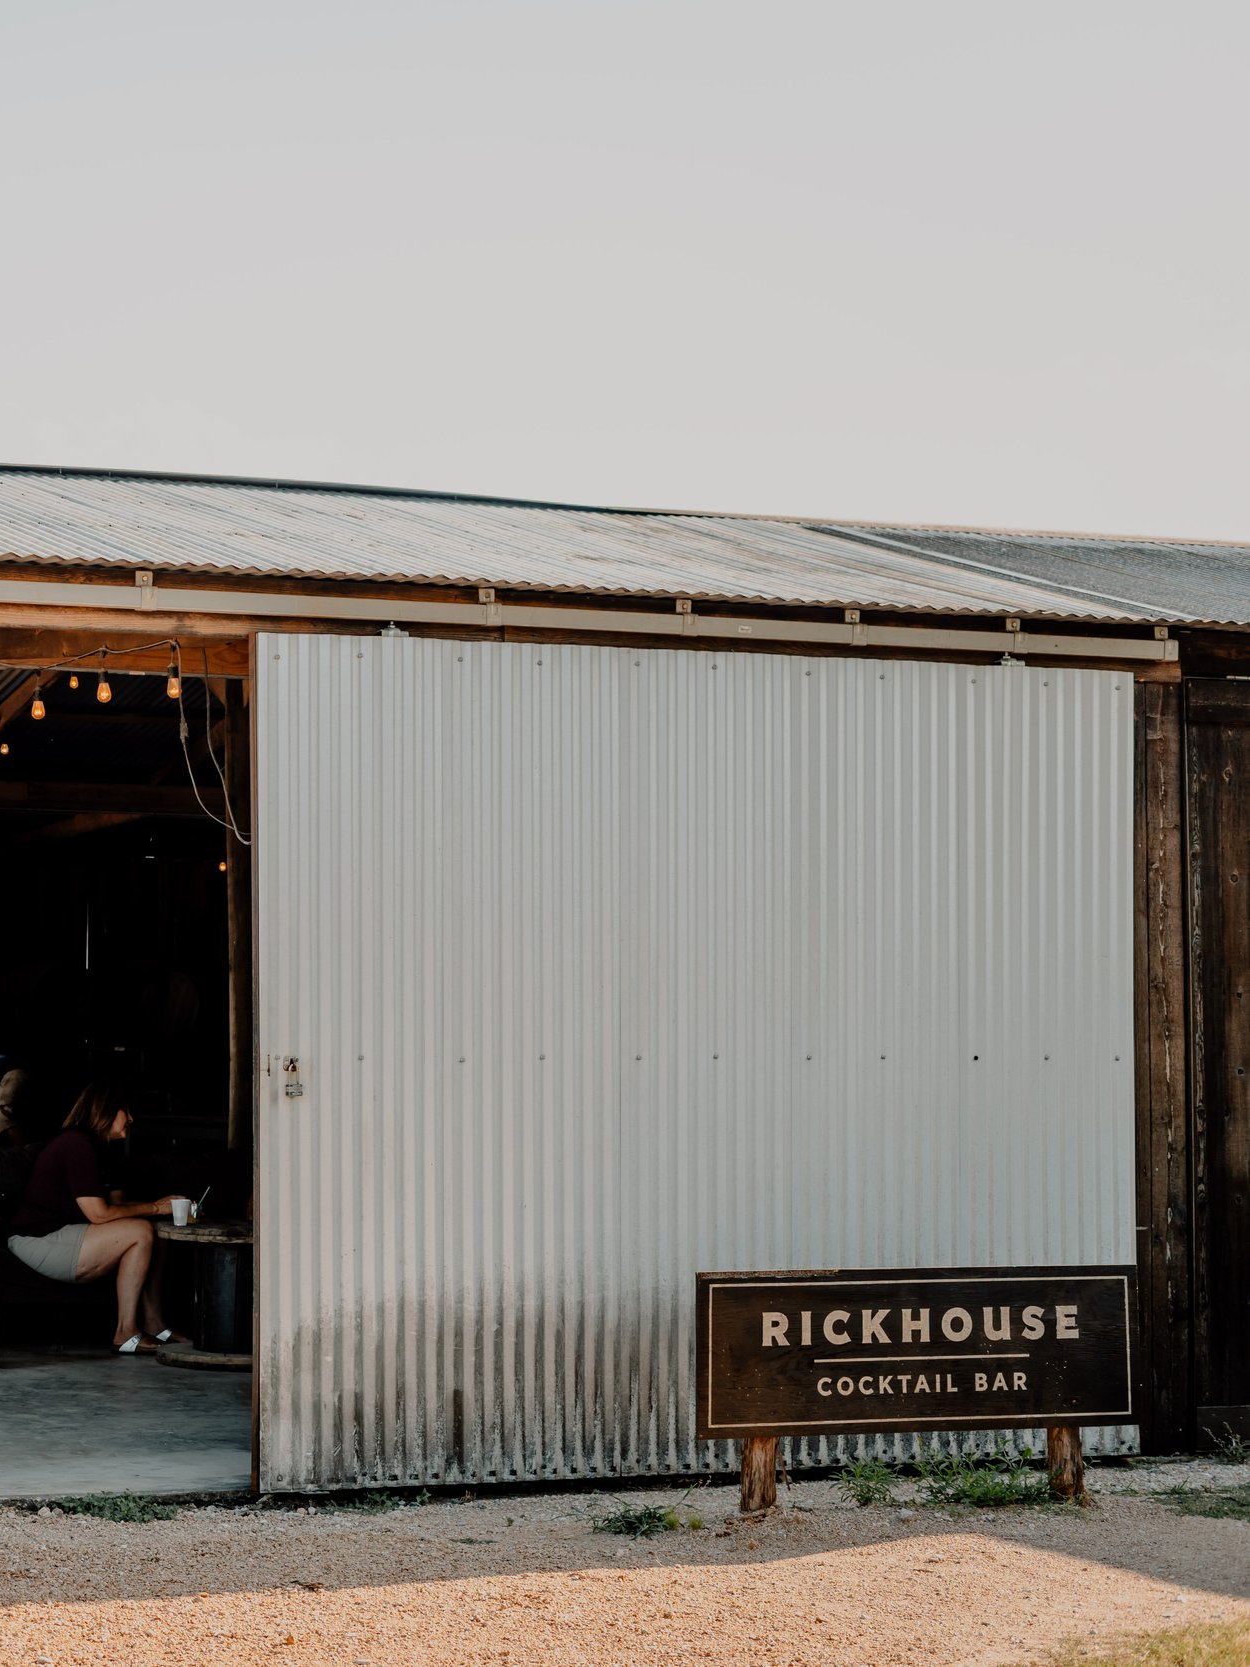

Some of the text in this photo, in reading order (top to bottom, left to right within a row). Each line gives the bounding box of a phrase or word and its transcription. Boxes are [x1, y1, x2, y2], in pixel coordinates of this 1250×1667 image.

[761, 1304, 1080, 1347] RICKHOUSE
[816, 1371, 1028, 1397] COCKTAIL BAR
